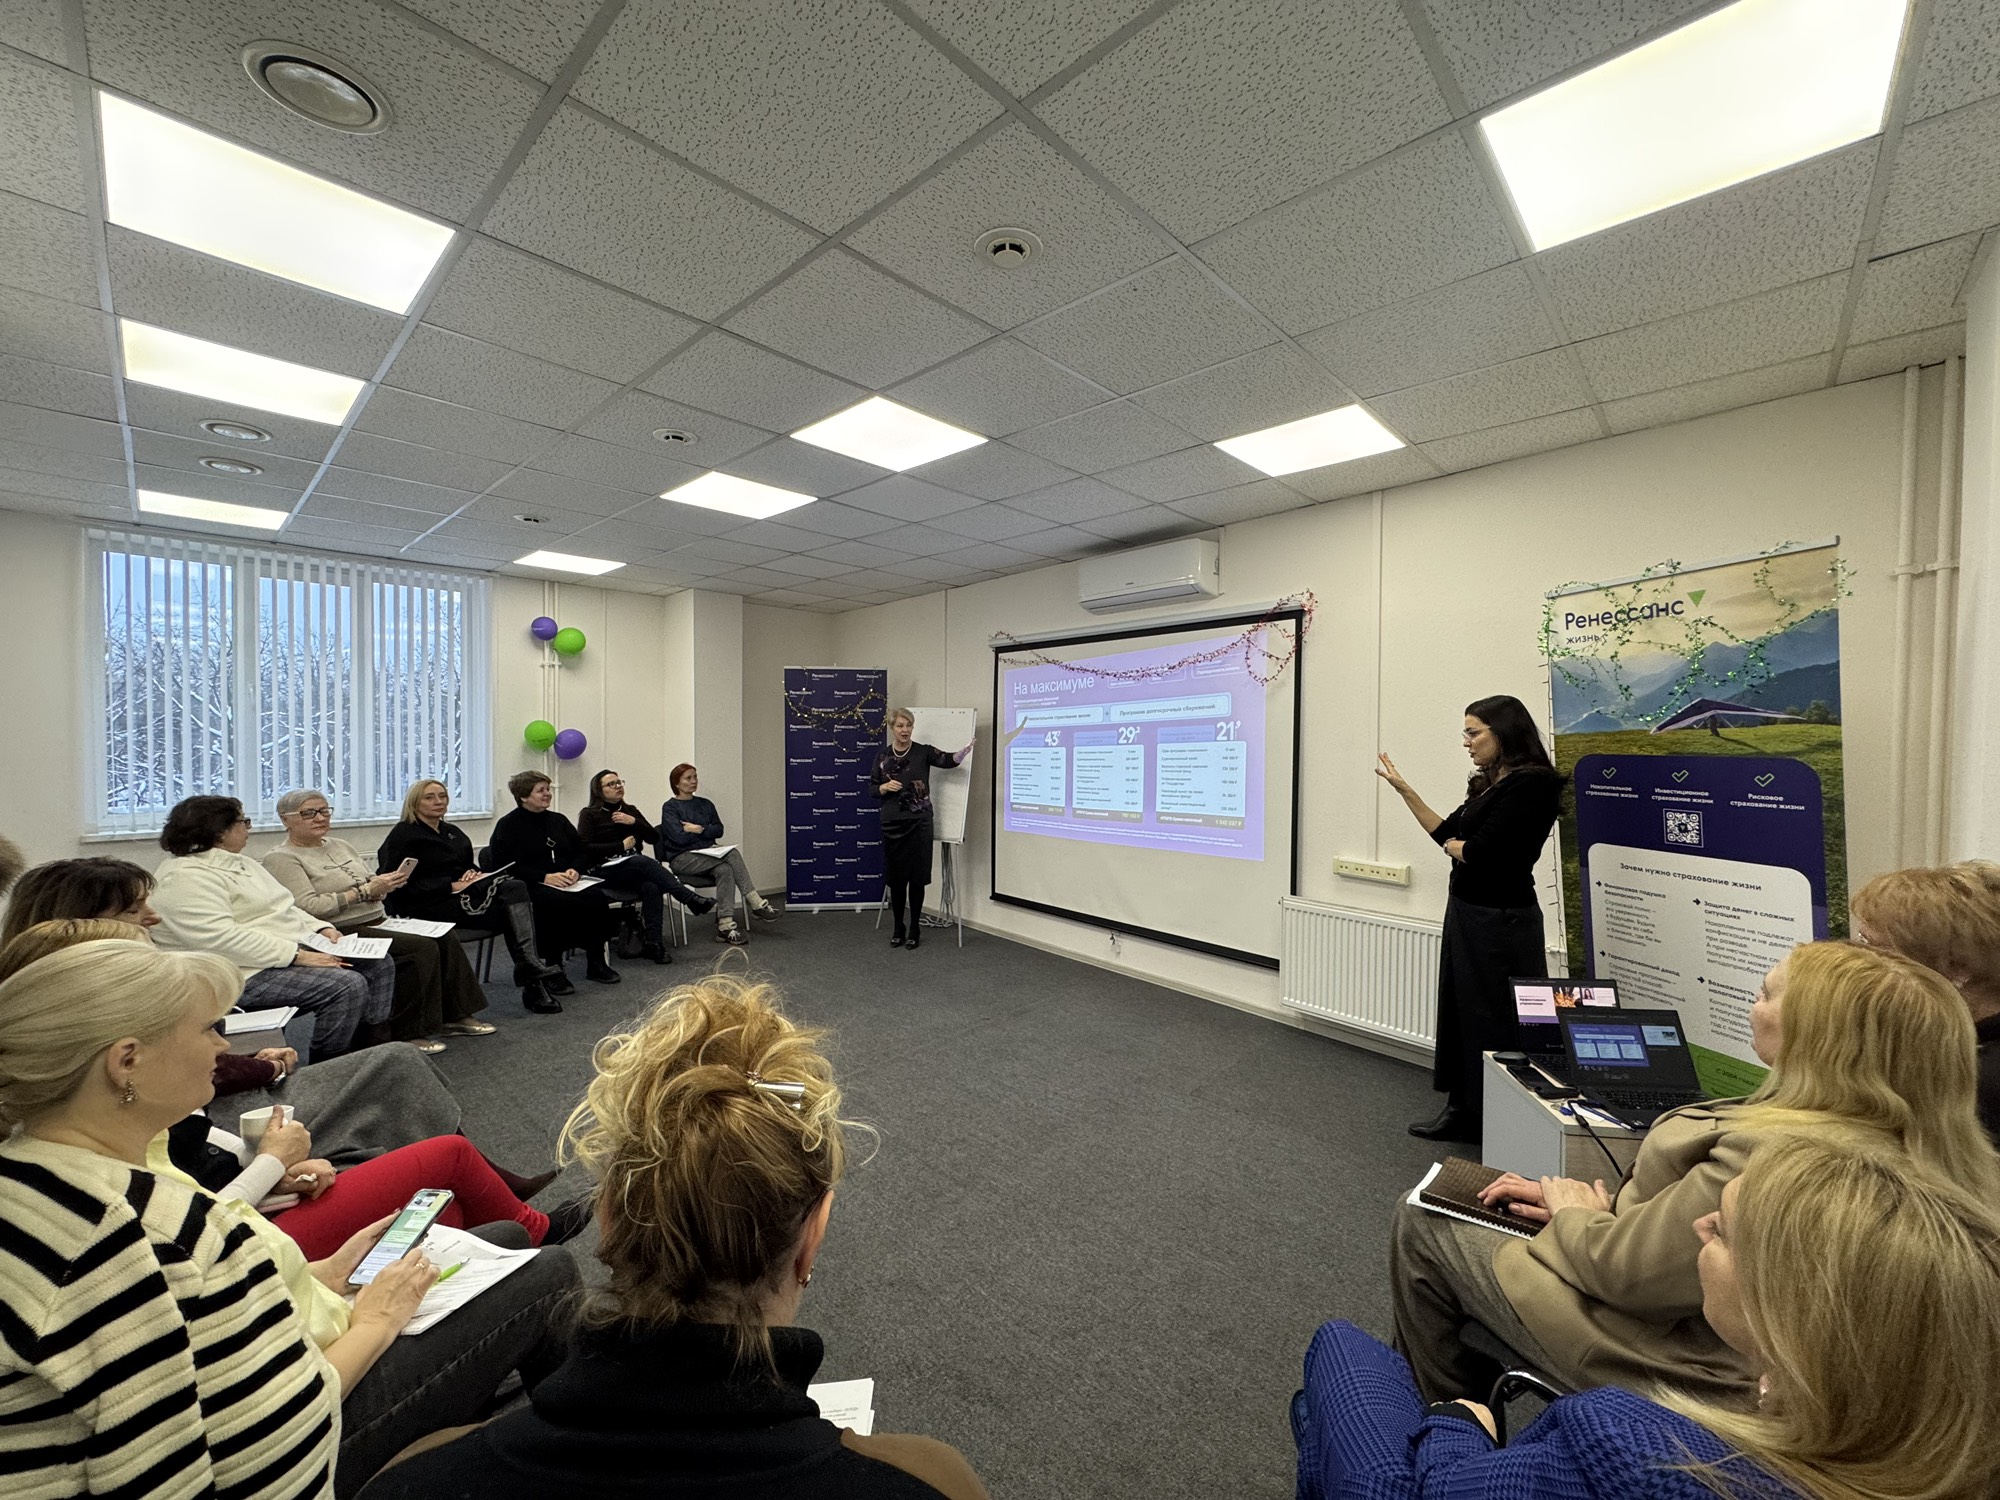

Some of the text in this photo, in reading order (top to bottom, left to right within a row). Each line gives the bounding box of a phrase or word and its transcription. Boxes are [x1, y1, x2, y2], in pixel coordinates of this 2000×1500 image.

[1565, 600, 1685, 630] Ренессанс
[1014, 676, 1094, 695] На максимуме
[1655, 787, 1709, 797] Инвестиционное
[1748, 793, 1784, 801] Рисковое
[1651, 794, 1691, 804] страхование
[1730, 800, 1805, 811] страхование жизни
[1620, 863, 1762, 891] Зачем нужно страхование жизни
[1704, 901, 1731, 911] Защита
[1732, 907, 1752, 915] денег
[1759, 911, 1795, 922] сложных
[1704, 909, 1741, 920] ситуациях
[1757, 931, 1794, 942] подлежат
